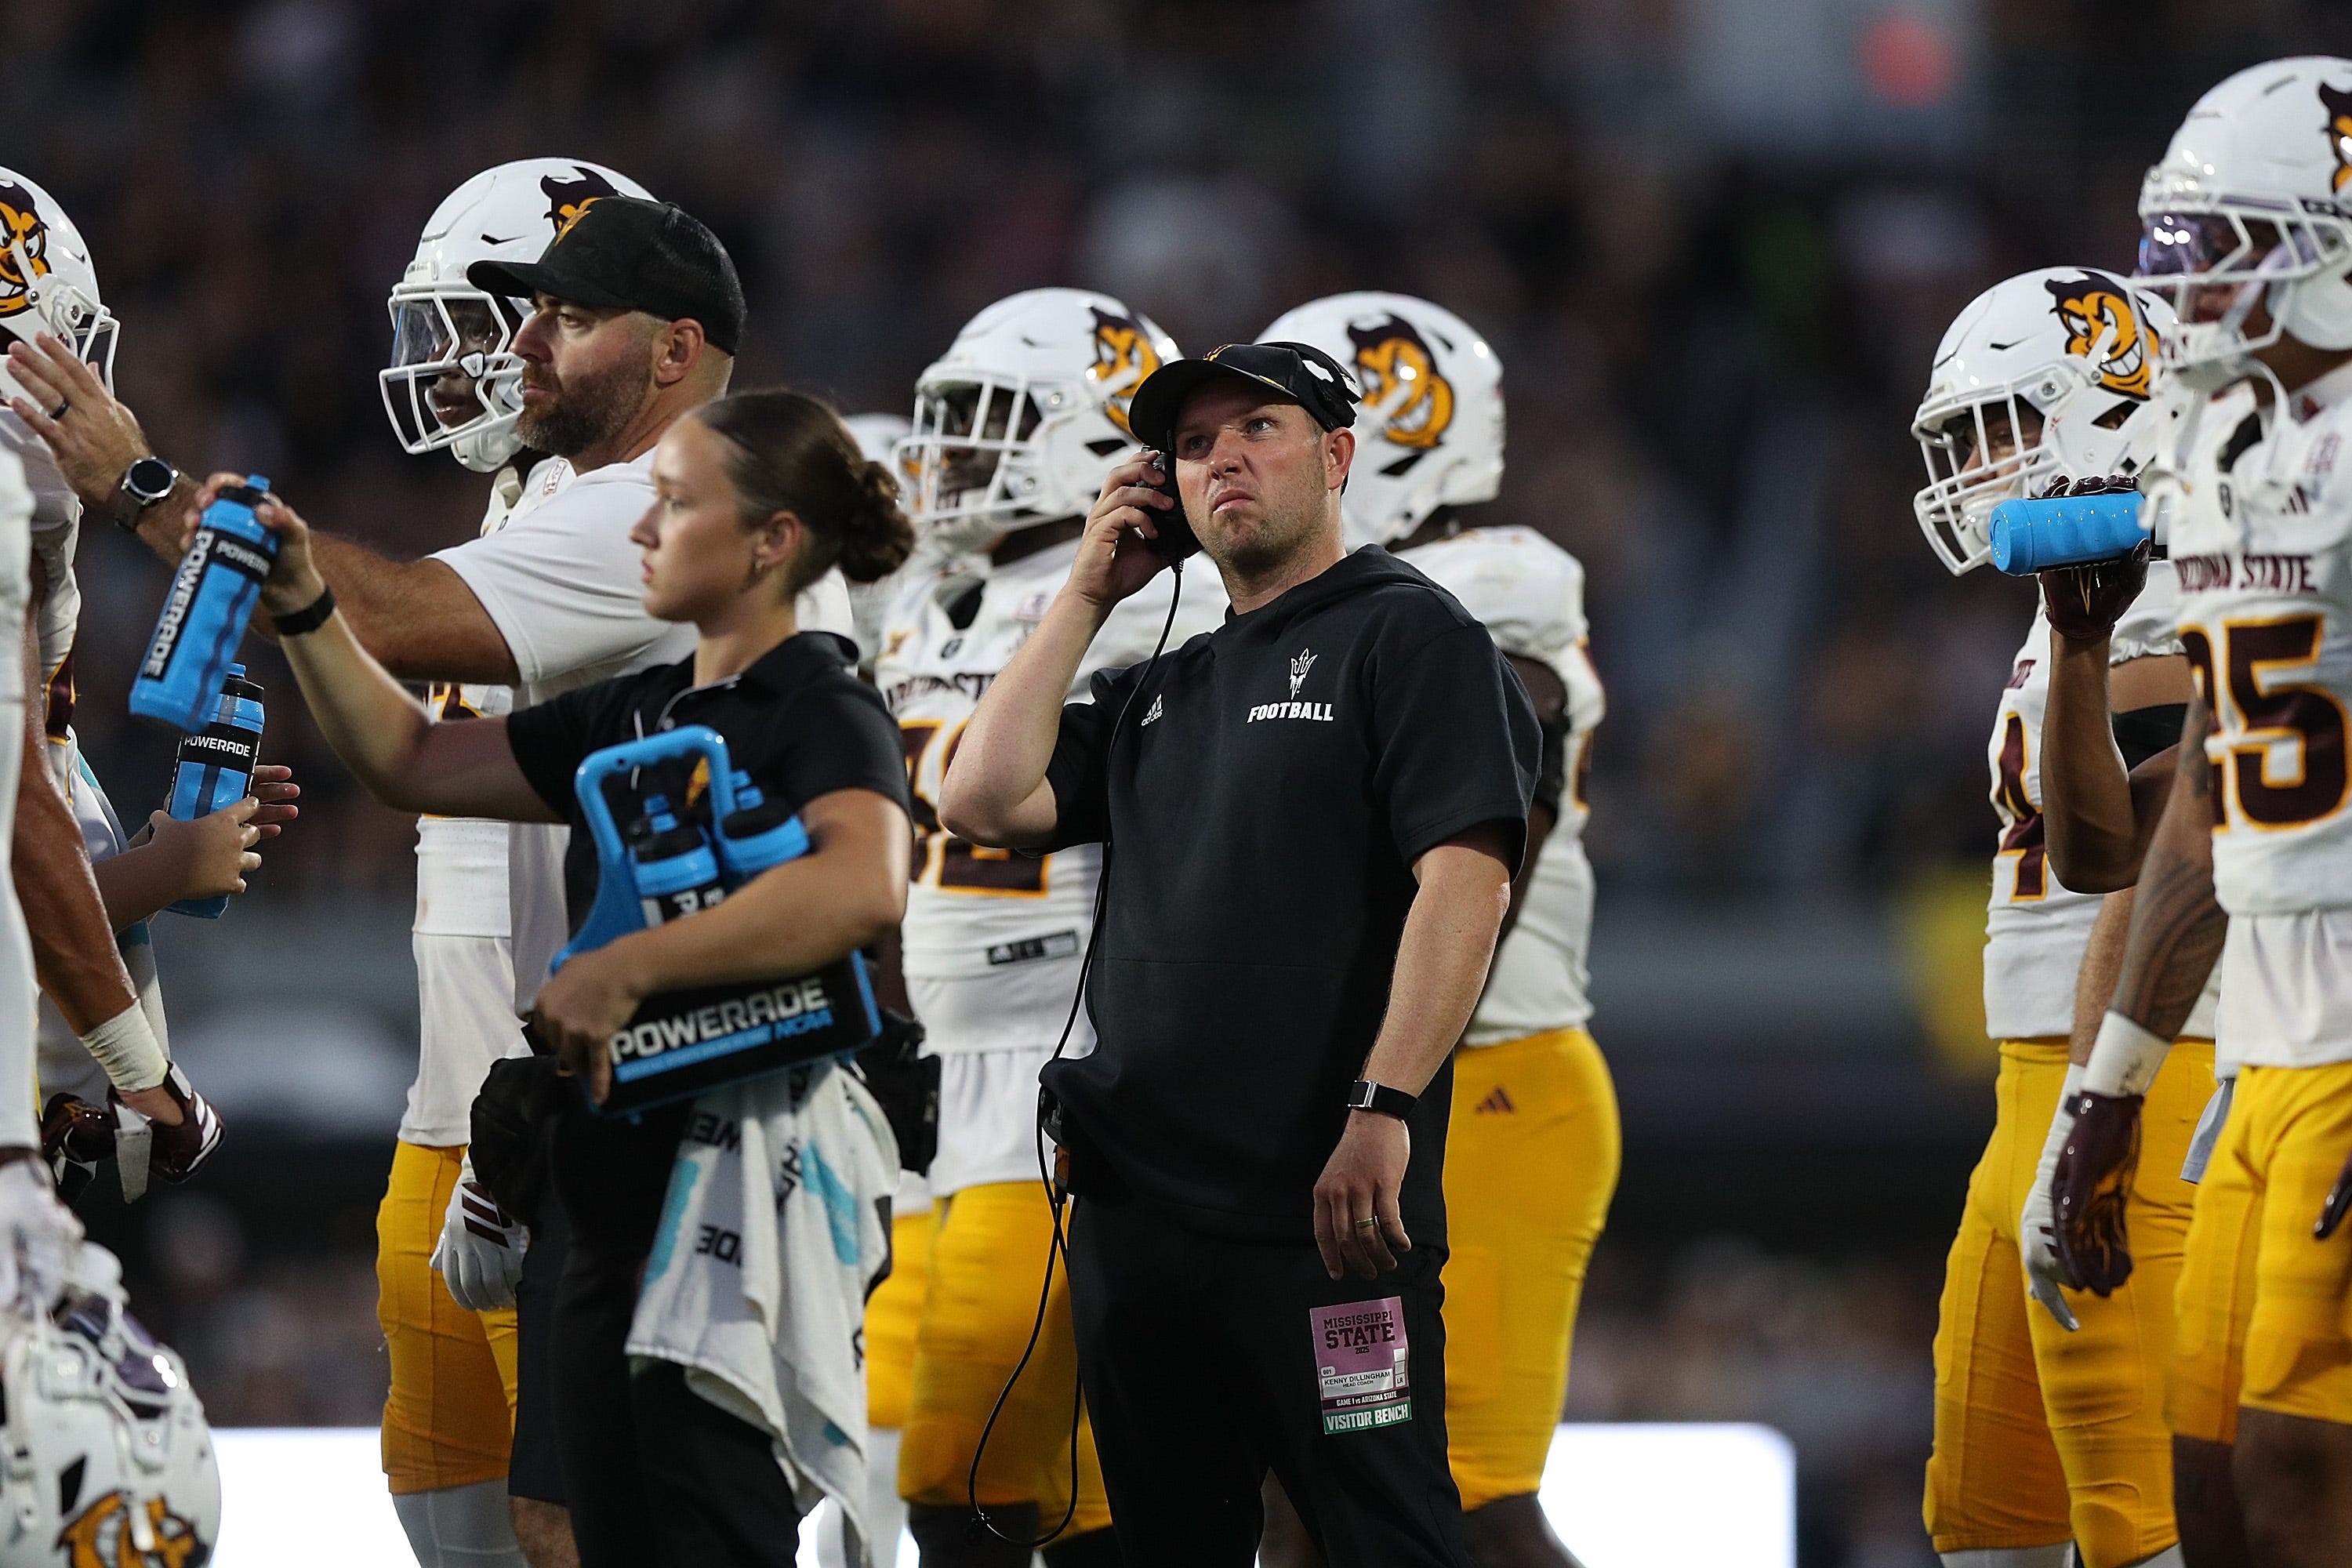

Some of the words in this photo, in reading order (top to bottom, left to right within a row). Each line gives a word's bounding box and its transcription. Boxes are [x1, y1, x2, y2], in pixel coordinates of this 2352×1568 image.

[143, 529, 215, 677] POWERADE
[1247, 701, 1334, 724] FOOTBALL
[183, 735, 251, 757] POWERADE
[609, 977, 829, 1066] POWERADE
[1323, 1310, 1393, 1330] MISSISSIPPI
[1325, 1322, 1396, 1349] STATE
[1324, 1377, 1348, 1386] KENNY
[1348, 1371, 1391, 1383] DILLINGHAM
[1336, 1398, 1352, 1406] GAME
[1361, 1394, 1384, 1403] ARIZONA
[1384, 1391, 1397, 1399] STATE
[1326, 1410, 1373, 1431] VISITOR
[1374, 1403, 1409, 1425] BENCH
